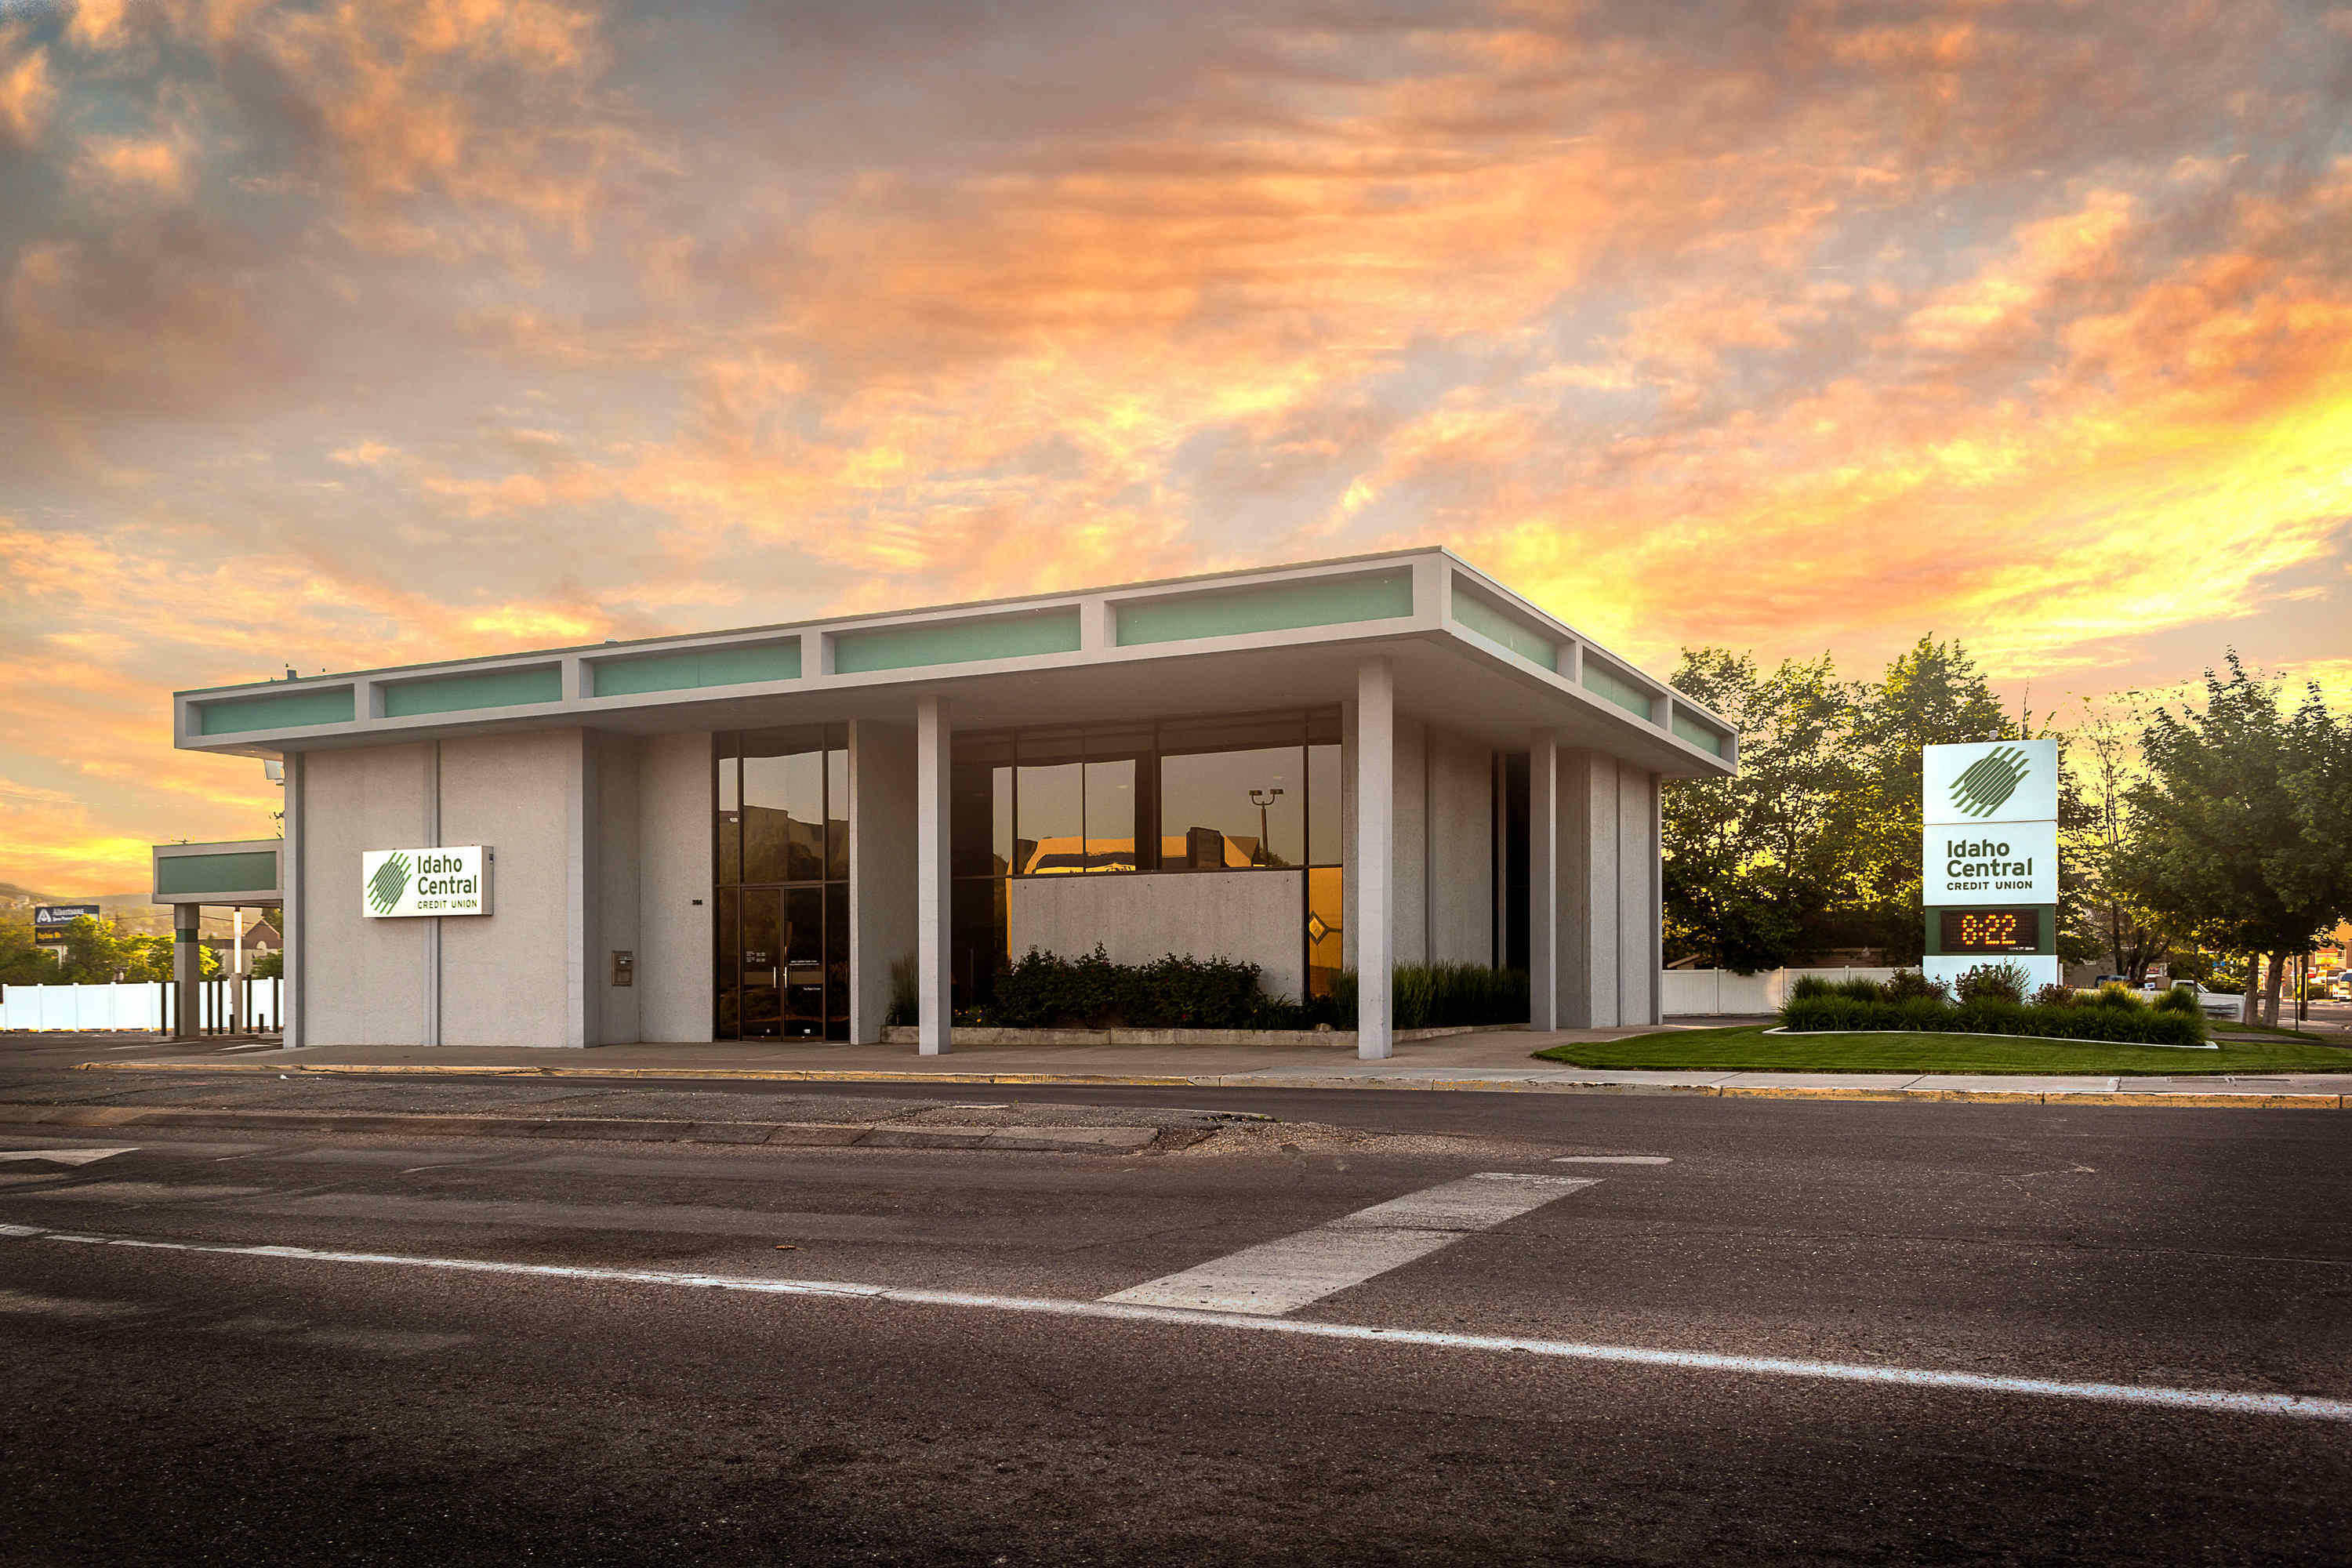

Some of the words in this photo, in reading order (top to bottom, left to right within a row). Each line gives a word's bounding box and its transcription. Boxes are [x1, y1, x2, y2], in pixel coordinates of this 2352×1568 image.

[1947, 839, 2010, 858] Idaho
[418, 855, 463, 873] Idaho
[1947, 858, 2033, 878] Central
[418, 875, 477, 895] Central
[1947, 881, 1990, 891] CREDIT
[1995, 880, 2033, 890] UNION
[417, 901, 447, 909] CREDIT
[451, 899, 477, 909] UNION
[1962, 915, 2016, 945] 8:22
